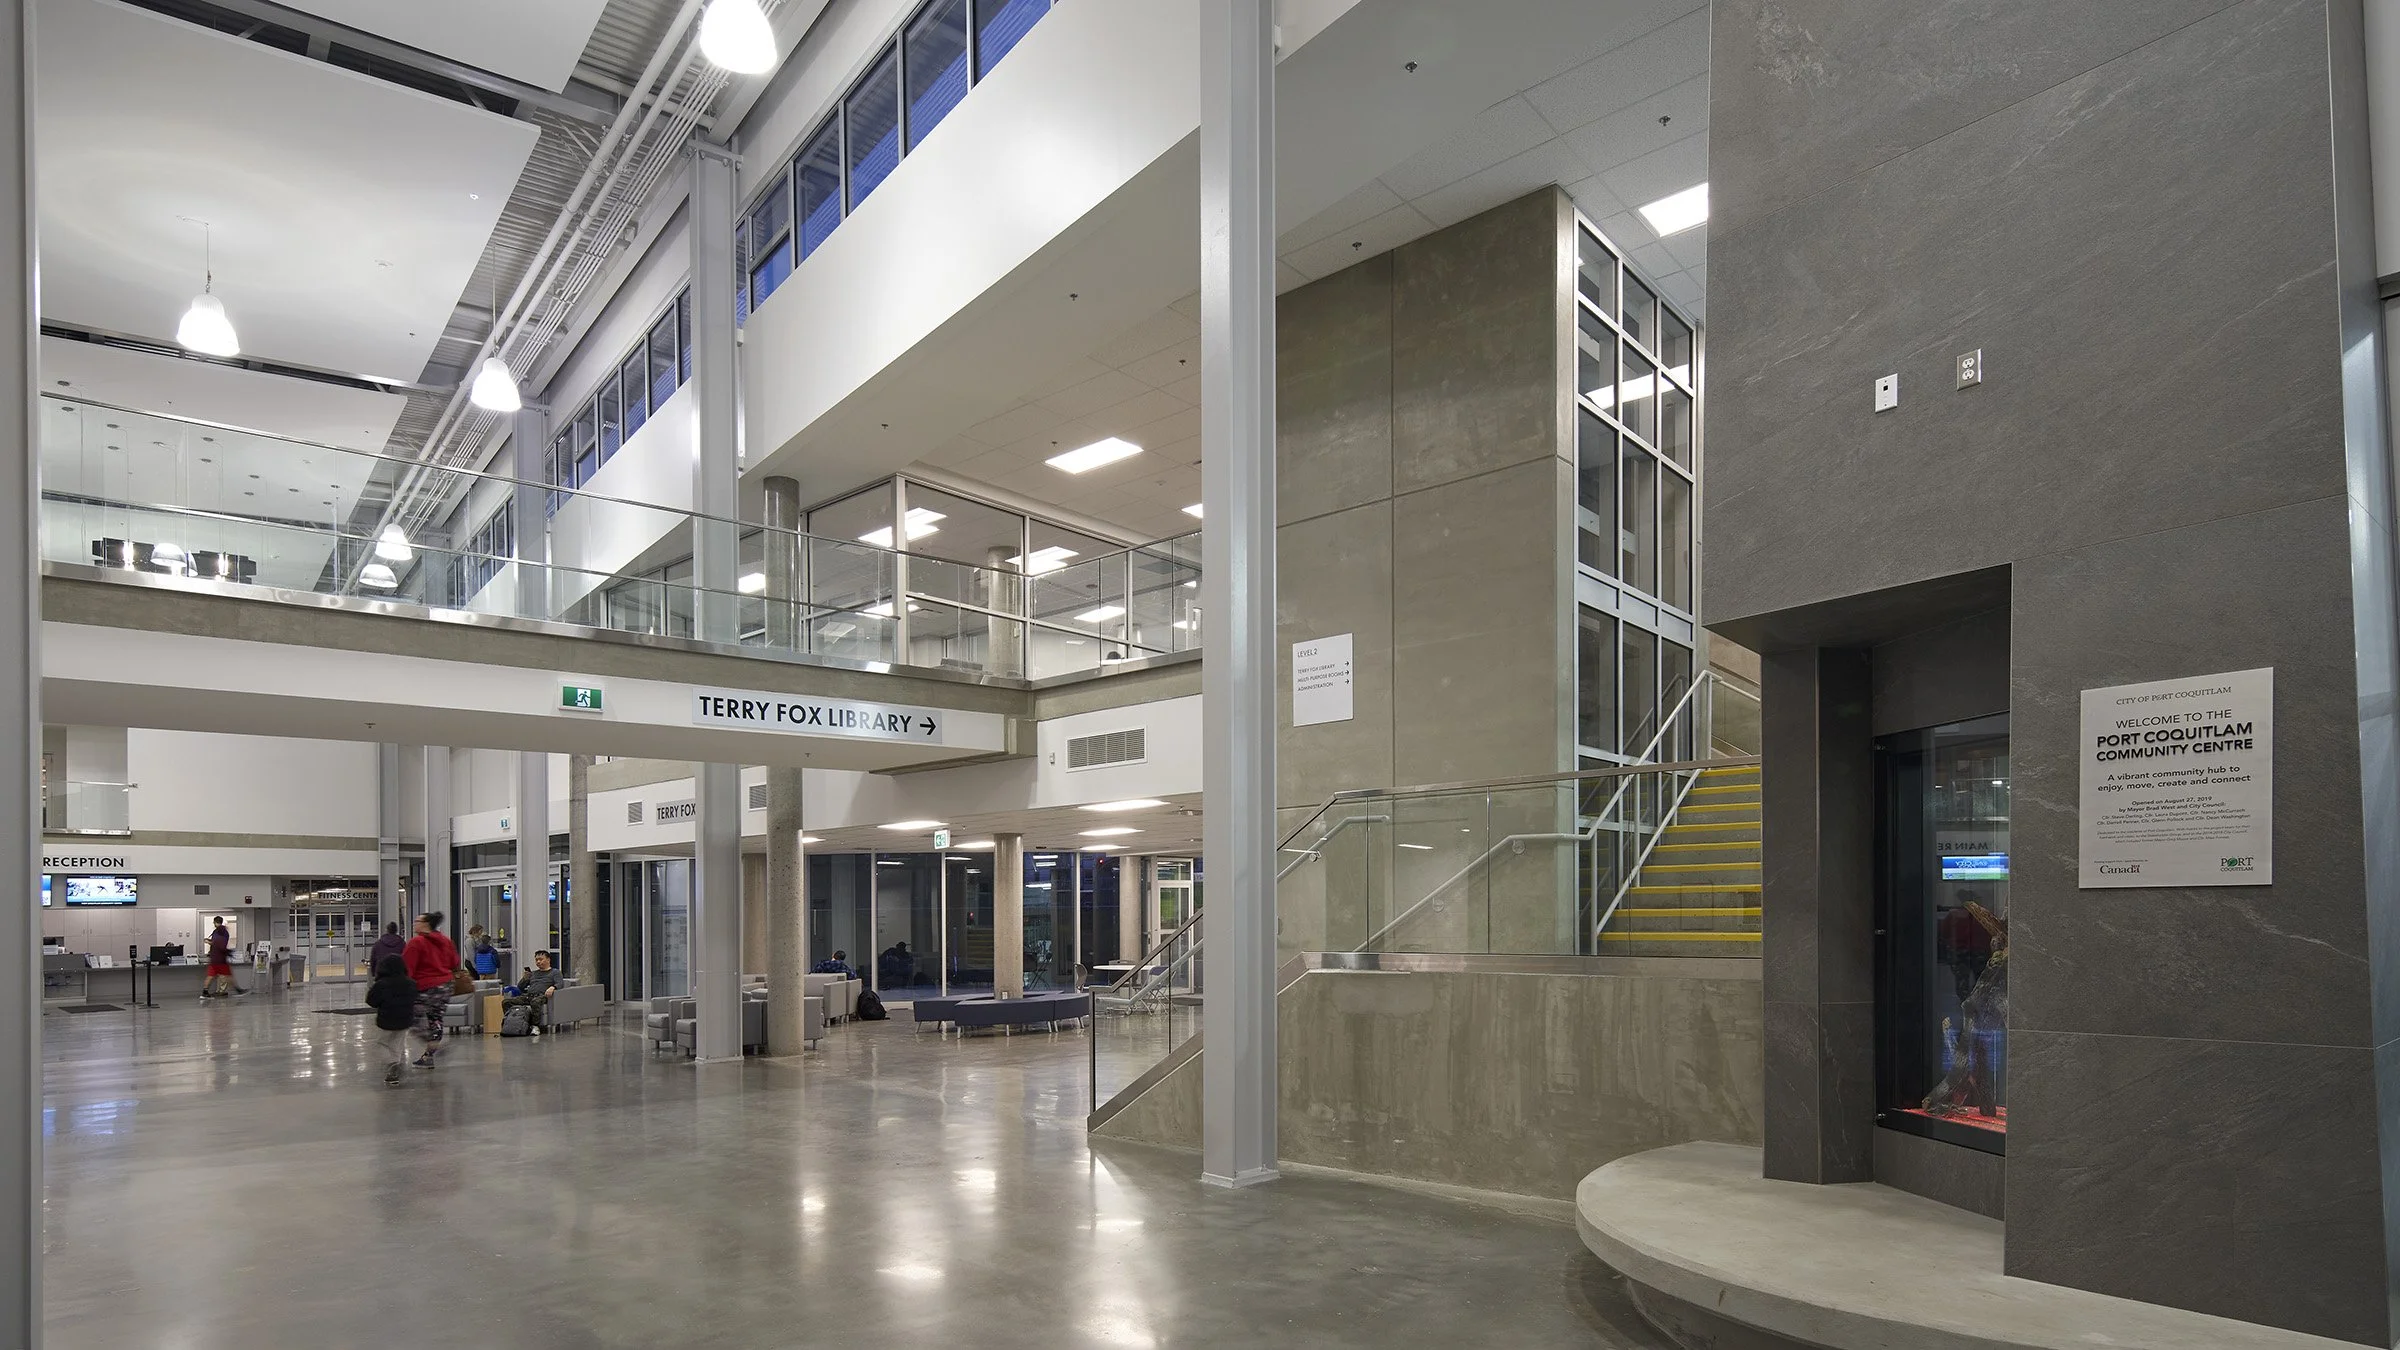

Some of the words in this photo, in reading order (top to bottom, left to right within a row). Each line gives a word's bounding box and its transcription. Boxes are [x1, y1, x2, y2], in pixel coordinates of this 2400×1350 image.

[2116, 697, 2136, 706] CITY
[2137, 695, 2150, 703] OF
[2151, 692, 2173, 702] PORT
[2175, 686, 2232, 699] COQUITLAM
[699, 696, 770, 721] TERRY
[777, 703, 822, 726] FOX
[828, 708, 912, 734] LIBRARY
[2115, 714, 2180, 729] WELCOME
[2184, 712, 2203, 722] TO
[2206, 709, 2232, 720] THE
[2097, 732, 2141, 748] PORT
[2144, 722, 2253, 743] COQUITLAM
[2096, 744, 2189, 762] COMMUNITY
[2192, 738, 2253, 754] CENTRE
[2117, 772, 2150, 781] vibrant
[2152, 768, 2205, 779] community
[2207, 765, 2227, 774] hub
[2097, 784, 2124, 793] enjoy,
[2126, 782, 2155, 790] move,
[2157, 779, 2188, 788] create
[2190, 776, 2208, 786] and
[2211, 775, 2252, 784] connect
[657, 805, 679, 820] TERRY
[680, 803, 696, 817] FOX
[43, 856, 124, 868] RECEPTION
[2099, 864, 2140, 874] Canada
[2220, 857, 2254, 867] PORT
[319, 891, 351, 900] FITNESS
